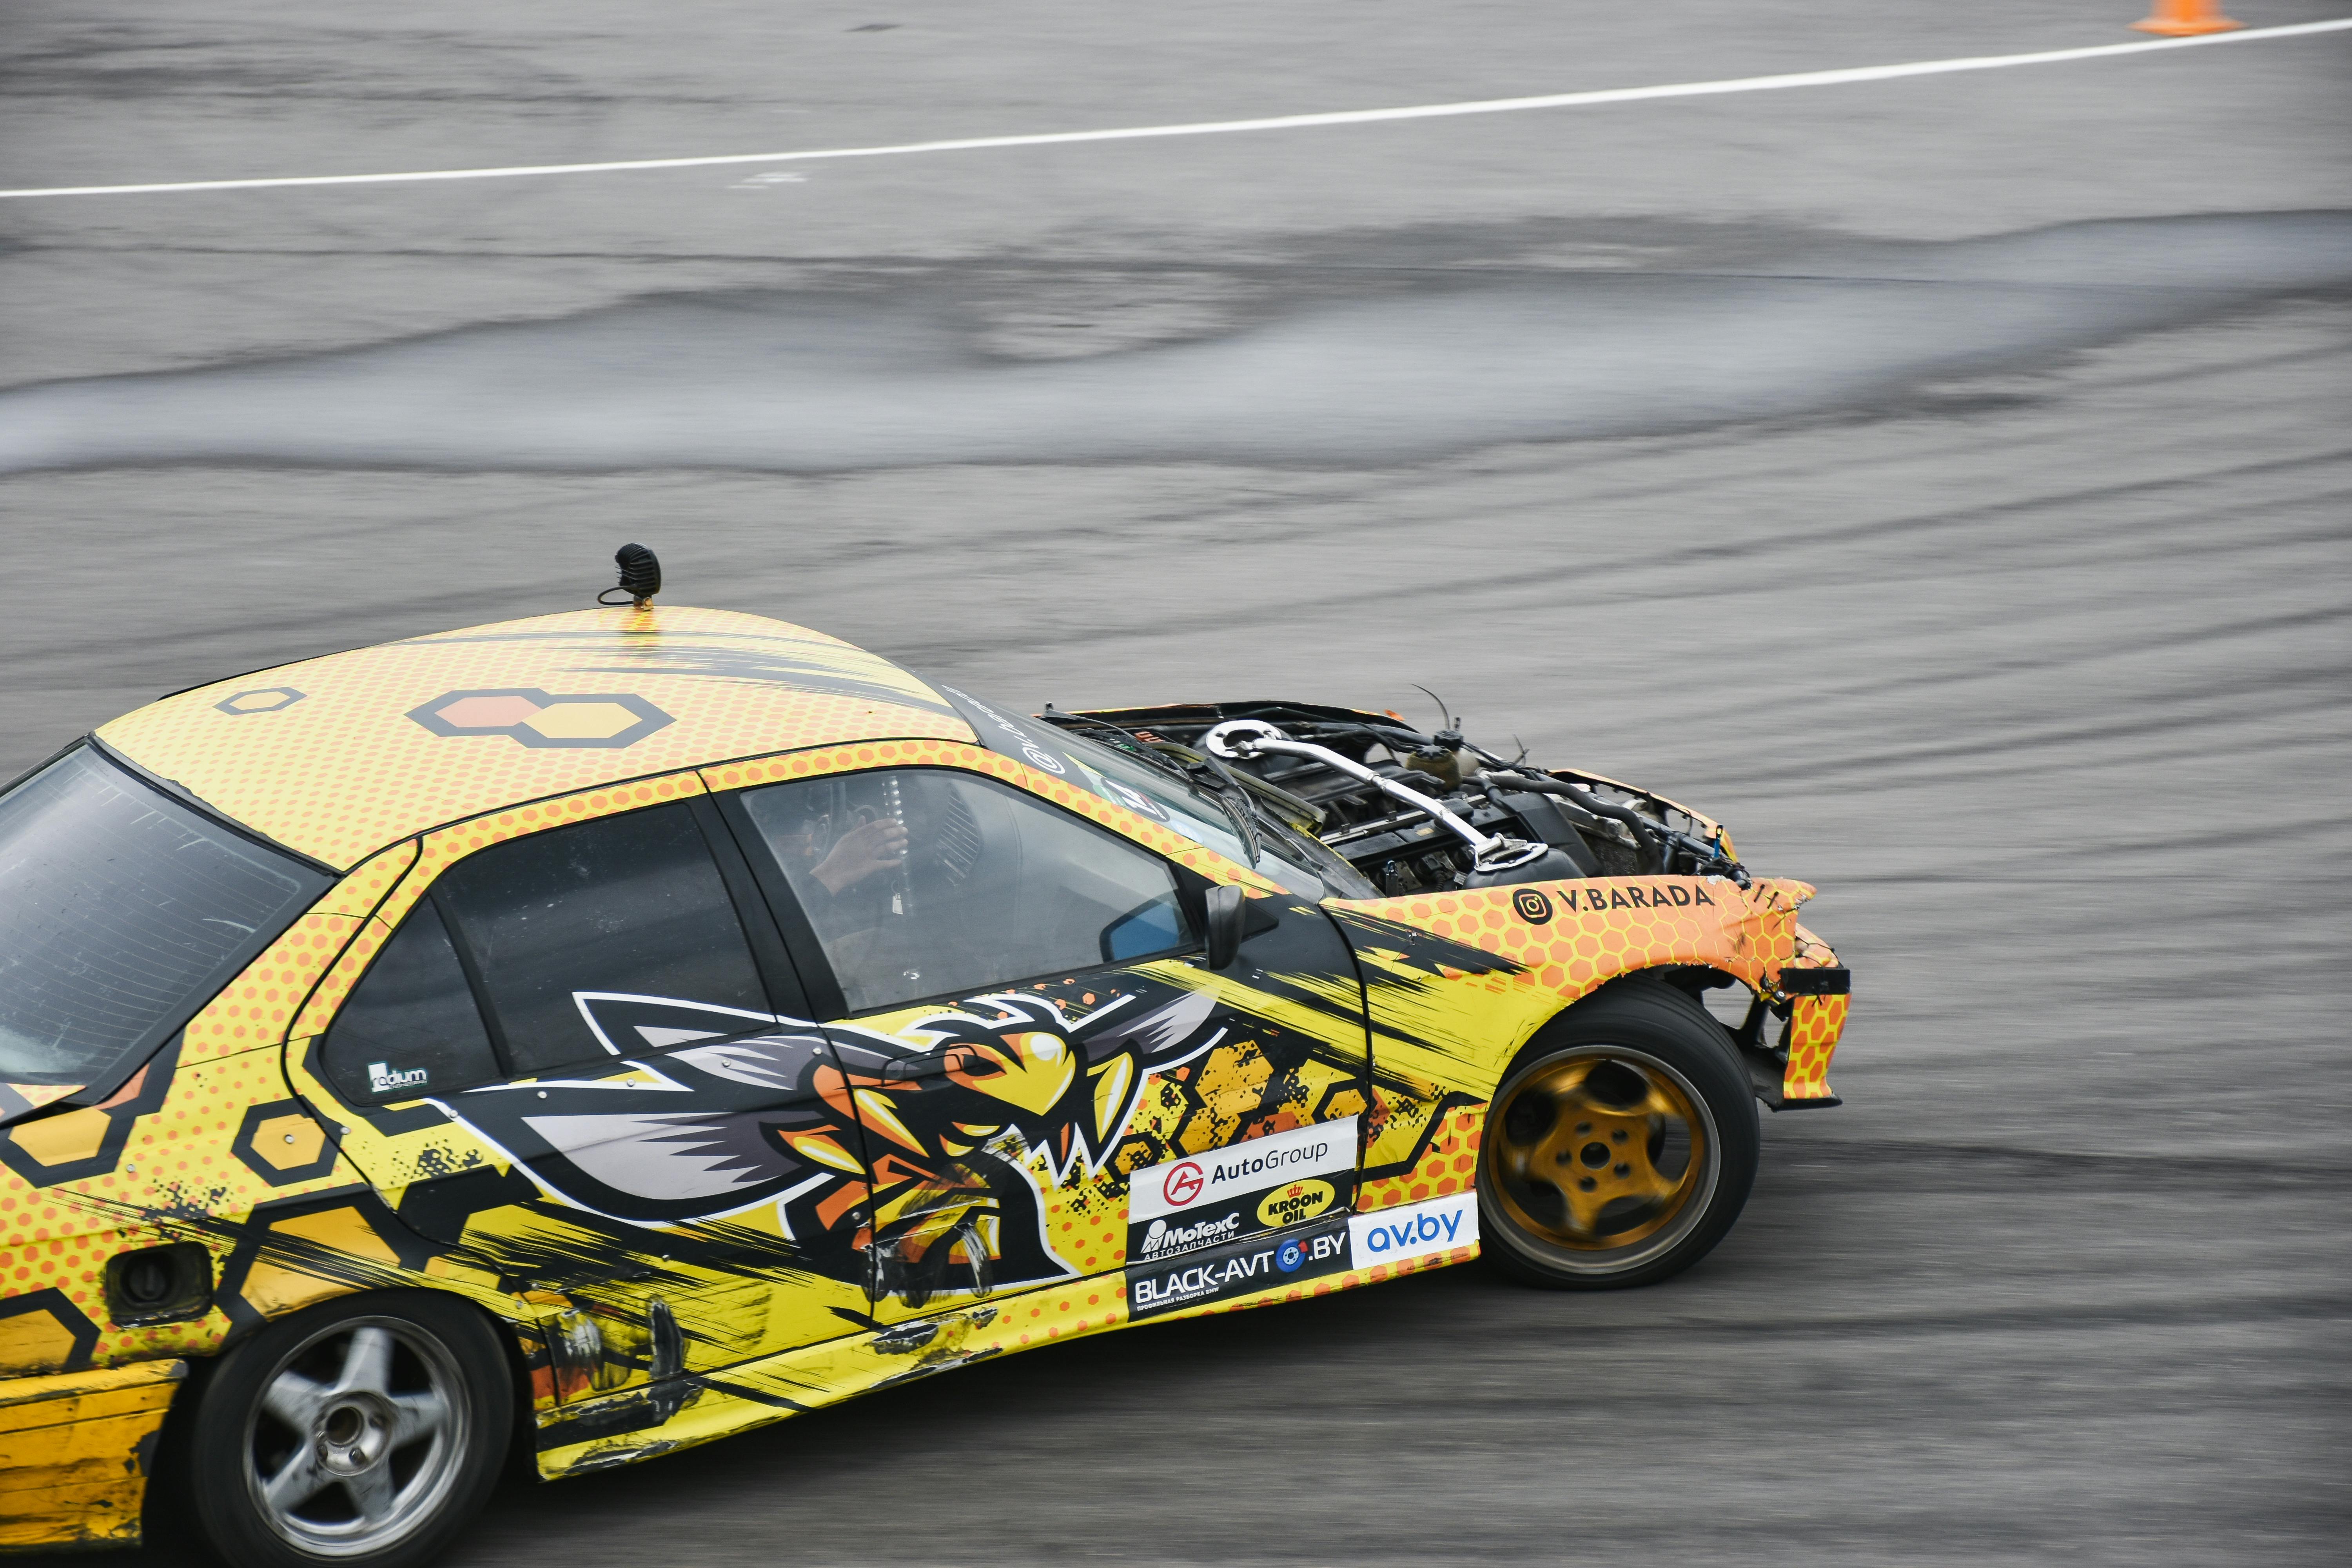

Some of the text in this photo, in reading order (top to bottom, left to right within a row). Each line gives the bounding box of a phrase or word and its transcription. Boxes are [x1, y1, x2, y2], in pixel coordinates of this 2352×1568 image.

[1557, 884, 1715, 913] V.BARADA
[1211, 1142, 1328, 1184] AutoGroup
[1268, 1191, 1323, 1216] KROON
[1282, 1208, 1306, 1224] OIL
[1367, 1209, 1463, 1252] av.by
[1144, 1230, 1234, 1261] АВТОЗАПЧАСТИ
[1136, 1297, 1175, 1311] ПРОФИЛЬНАЯ
[1176, 1291, 1205, 1302] РАЗБОРКА
